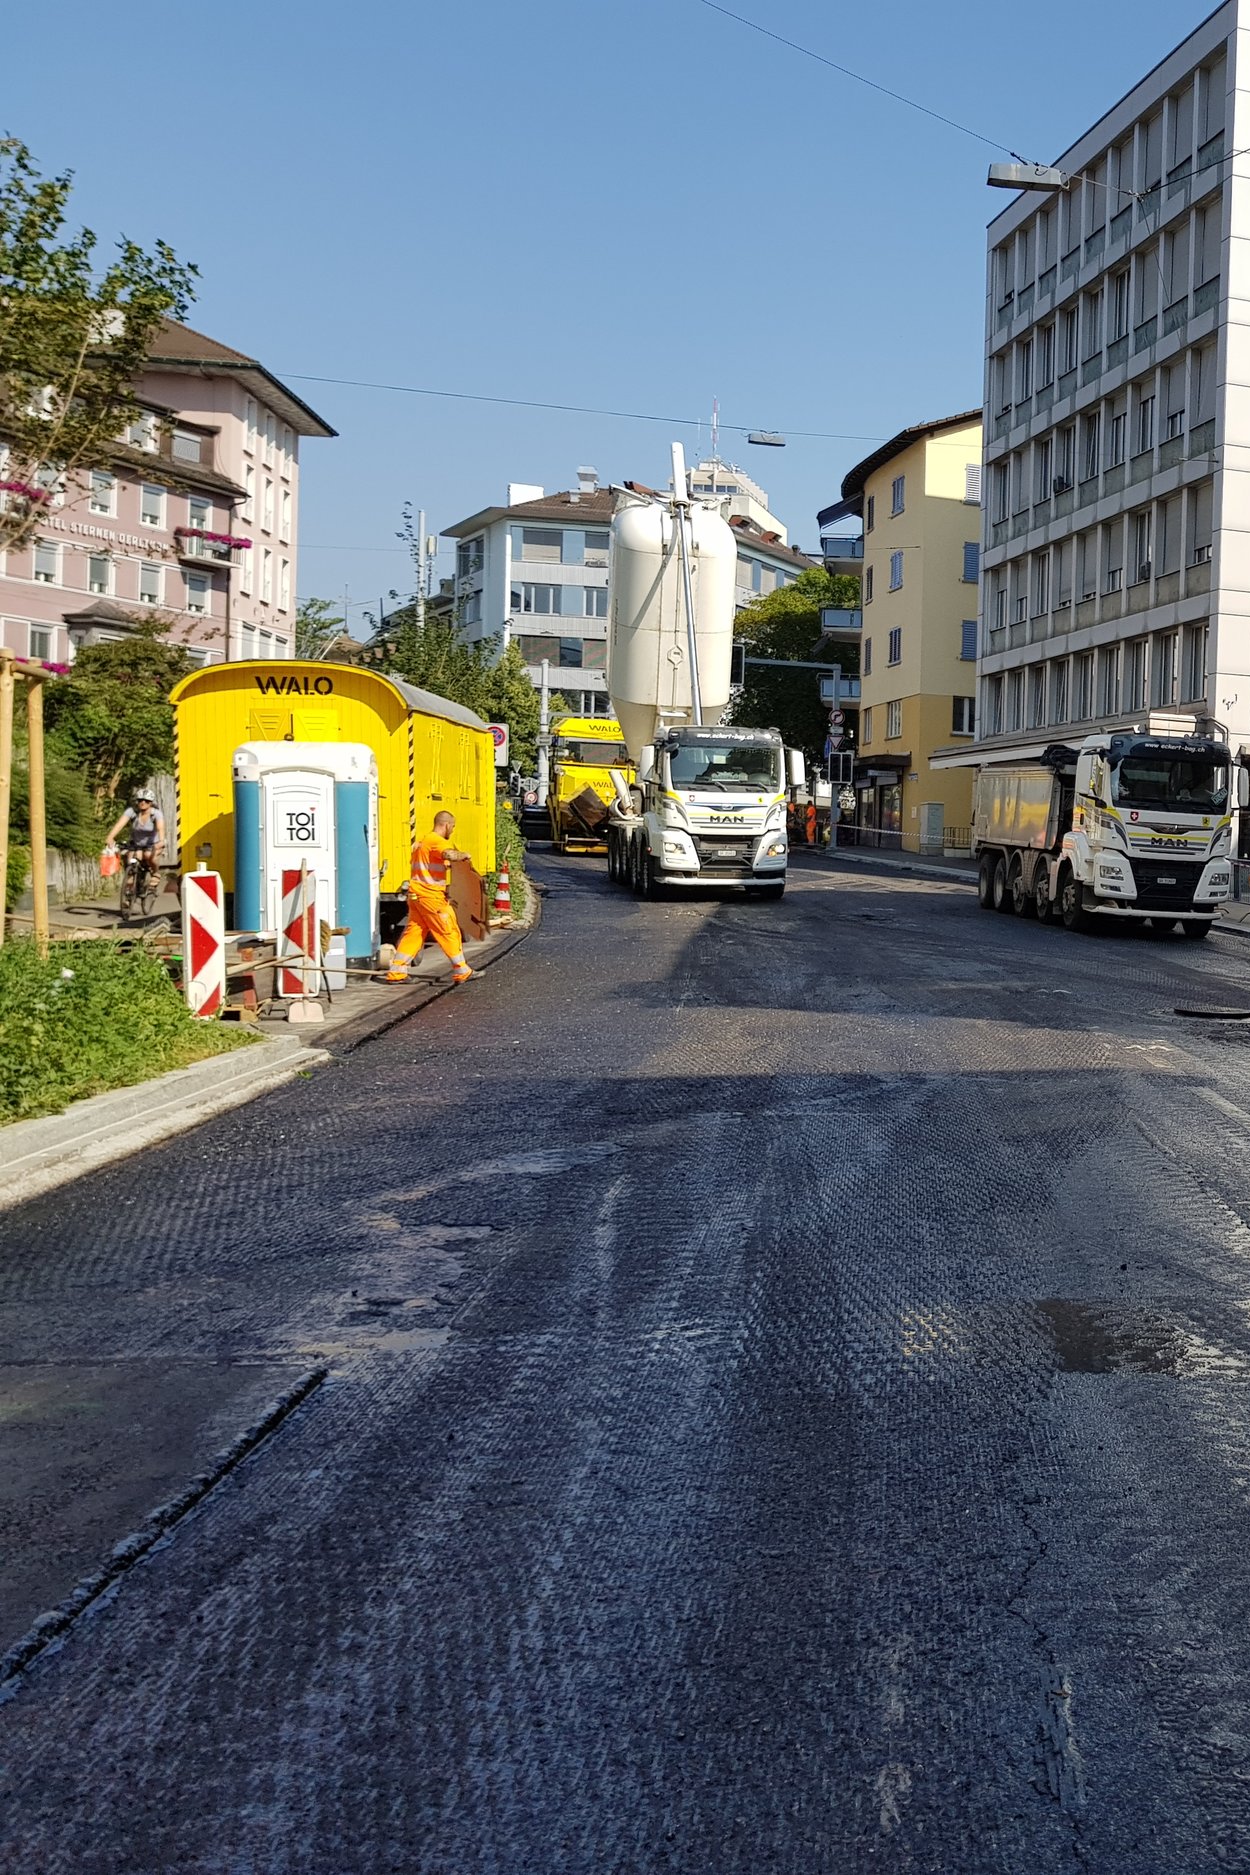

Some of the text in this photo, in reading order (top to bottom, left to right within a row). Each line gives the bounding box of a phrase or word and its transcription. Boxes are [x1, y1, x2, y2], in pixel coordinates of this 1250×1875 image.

[37, 515, 66, 531] OTEL
[71, 521, 115, 542] STERNEN
[255, 676, 333, 695] WALO
[588, 724, 621, 733] WALO
[709, 815, 745, 824] MAN
[286, 827, 315, 841] TOI
[1151, 837, 1188, 848] MAN
